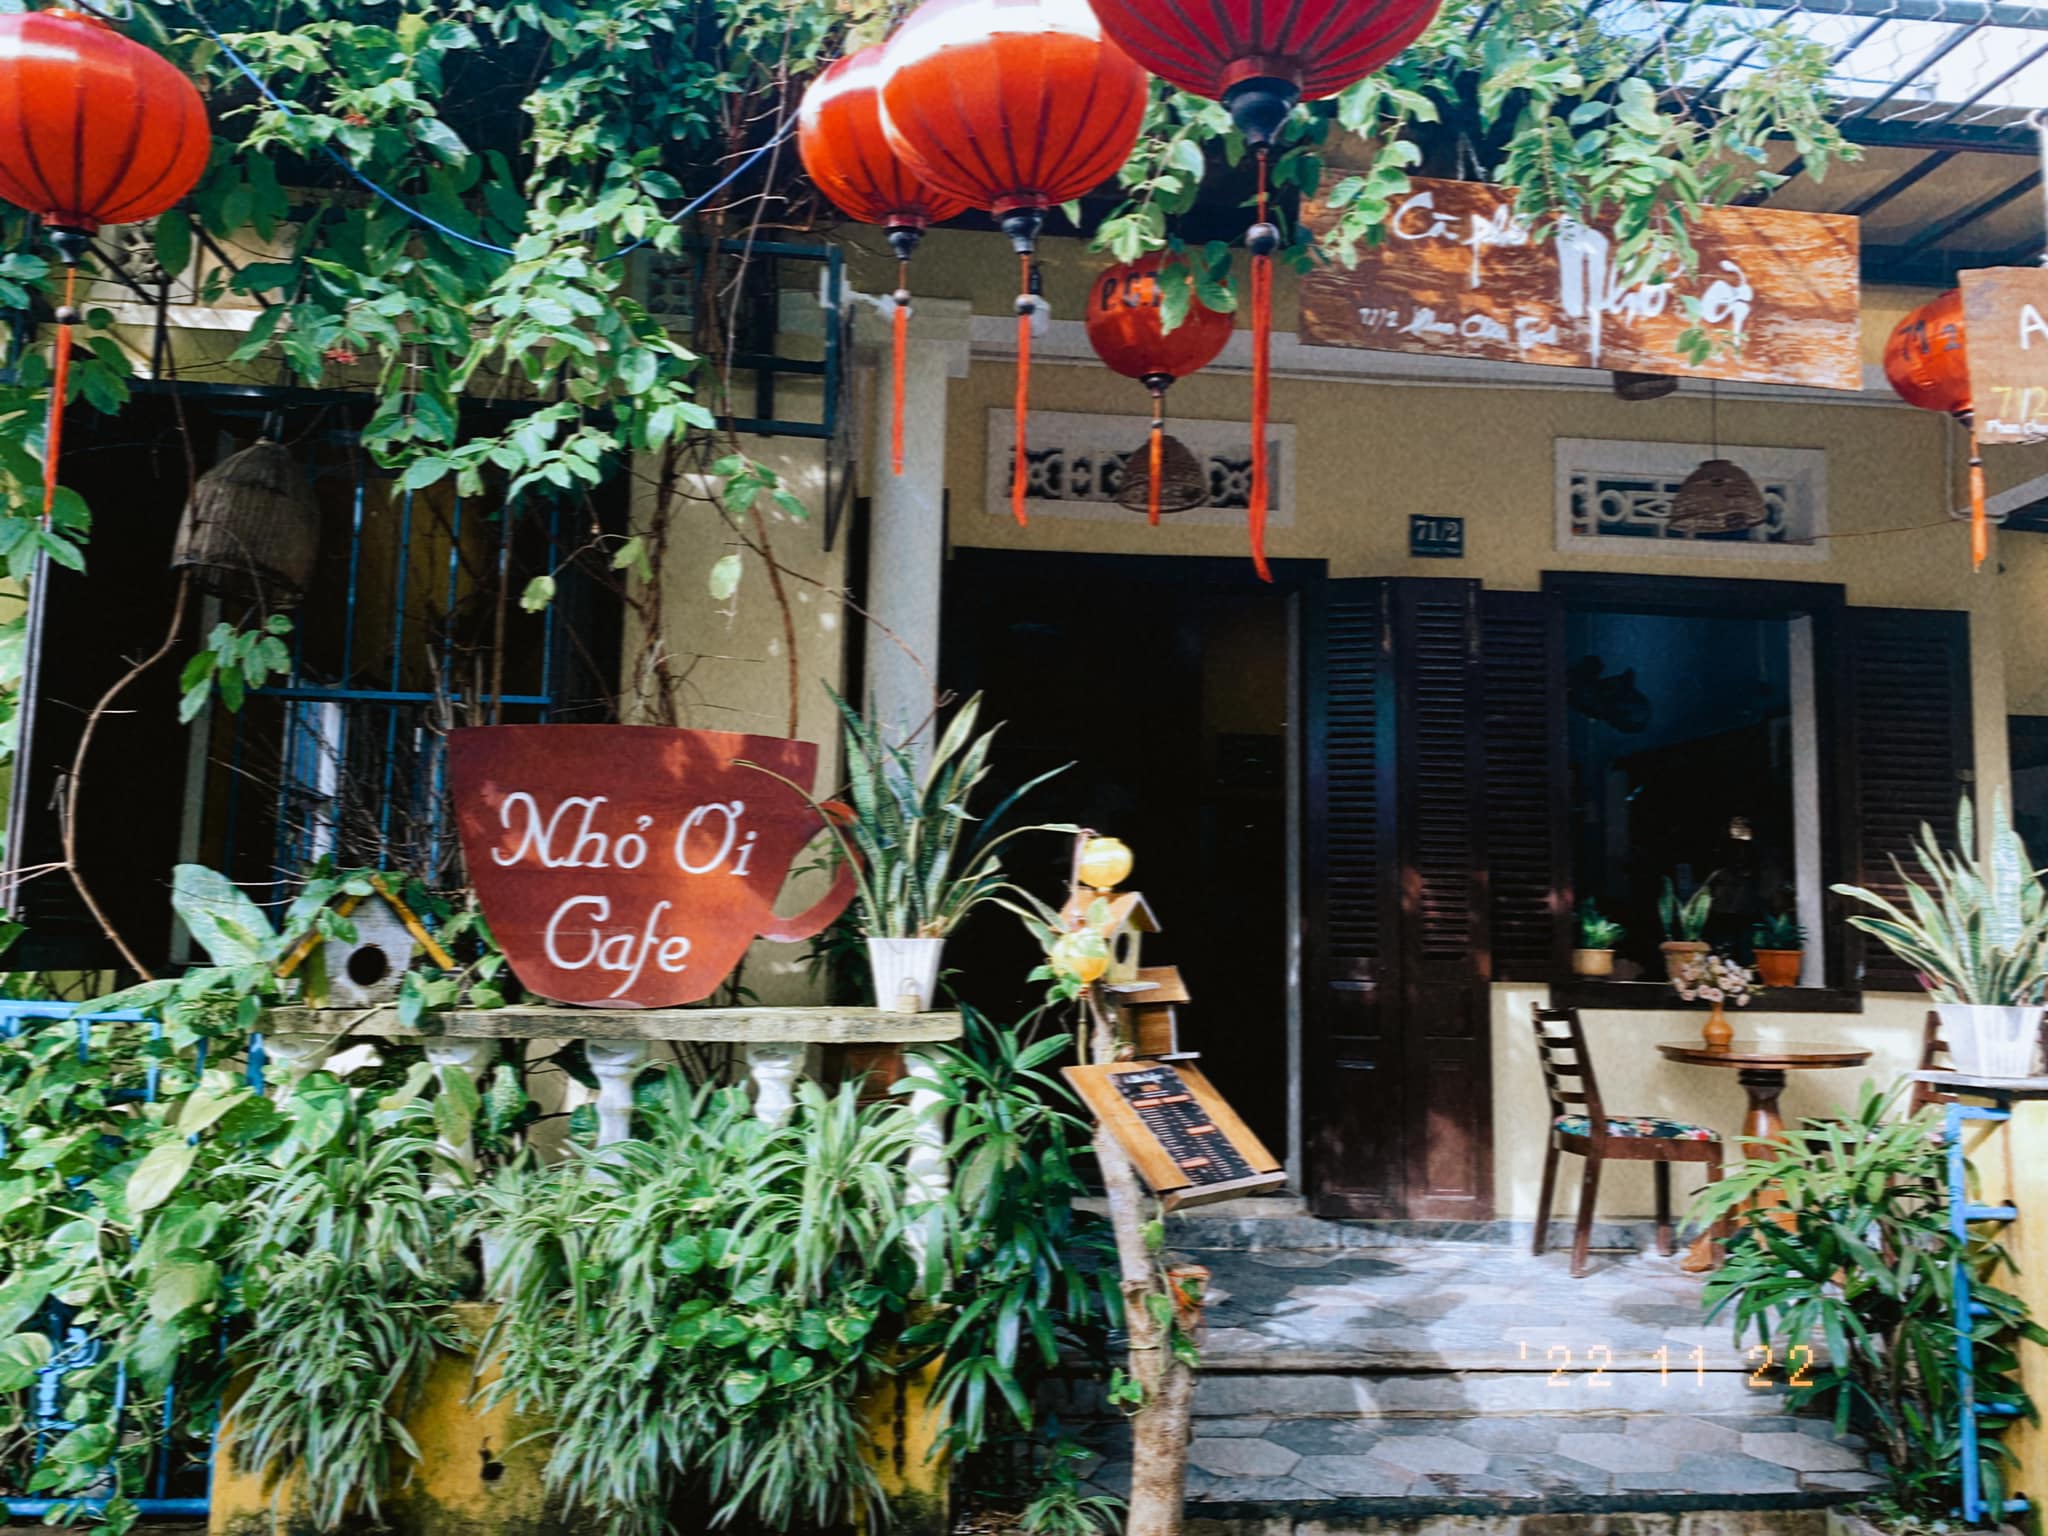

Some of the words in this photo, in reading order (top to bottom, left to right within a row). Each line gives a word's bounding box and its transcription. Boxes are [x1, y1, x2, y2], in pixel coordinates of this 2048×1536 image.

[491, 791, 655, 869] Nhỏ
[674, 799, 758, 877] Ơi
[543, 895, 692, 999] Cafe
